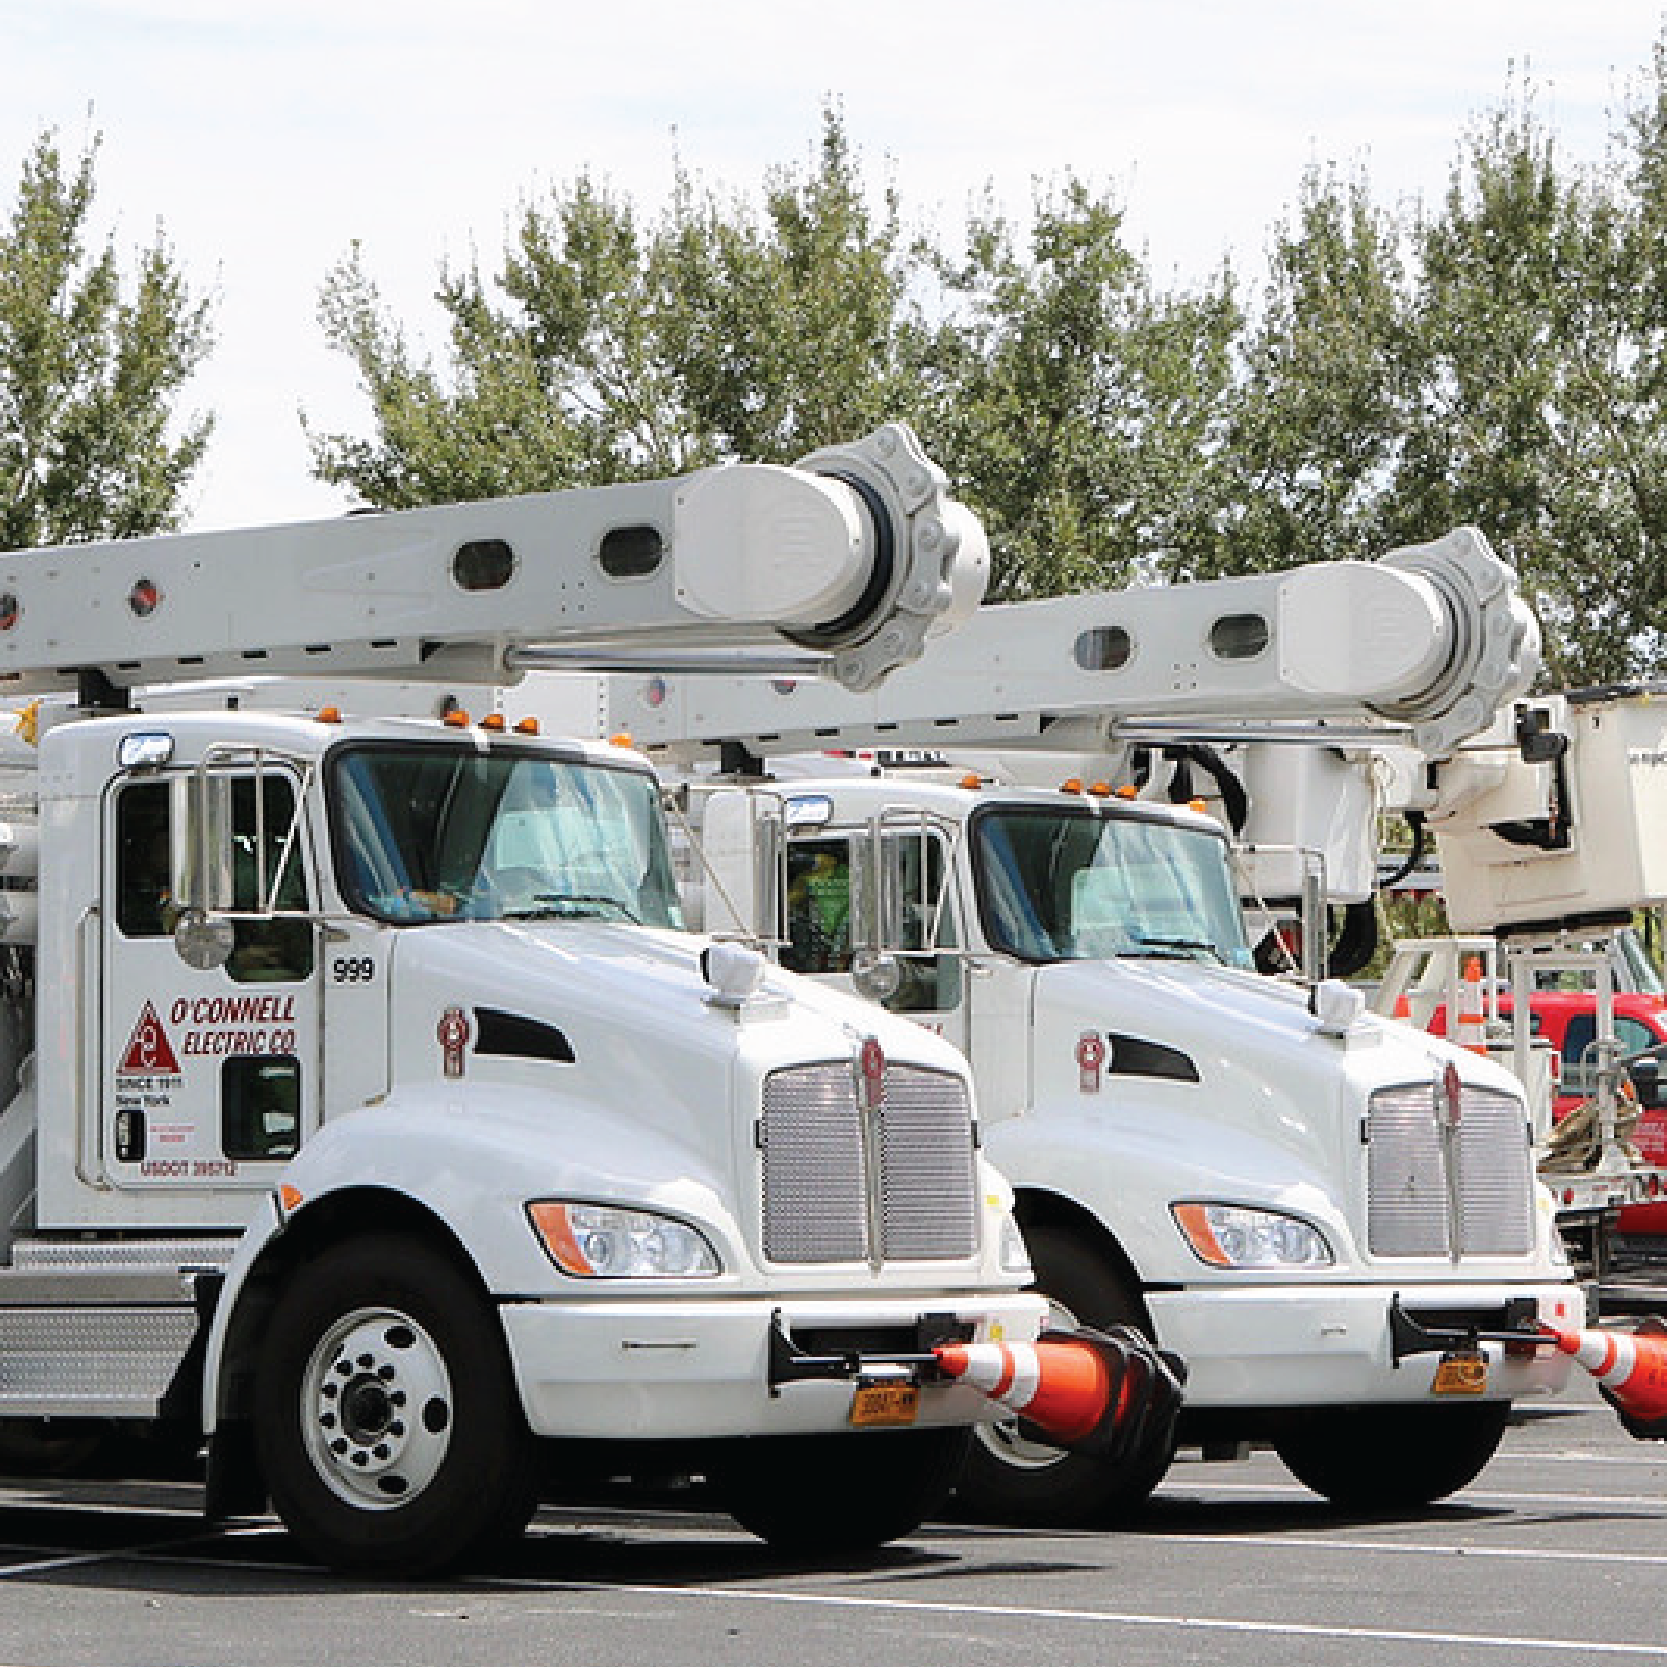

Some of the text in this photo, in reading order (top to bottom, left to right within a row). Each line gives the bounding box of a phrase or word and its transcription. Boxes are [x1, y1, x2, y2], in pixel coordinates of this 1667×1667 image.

[333, 957, 374, 983] 999
[170, 995, 295, 1024] O'CONNELL
[184, 1030, 266, 1055] ELECTRIC
